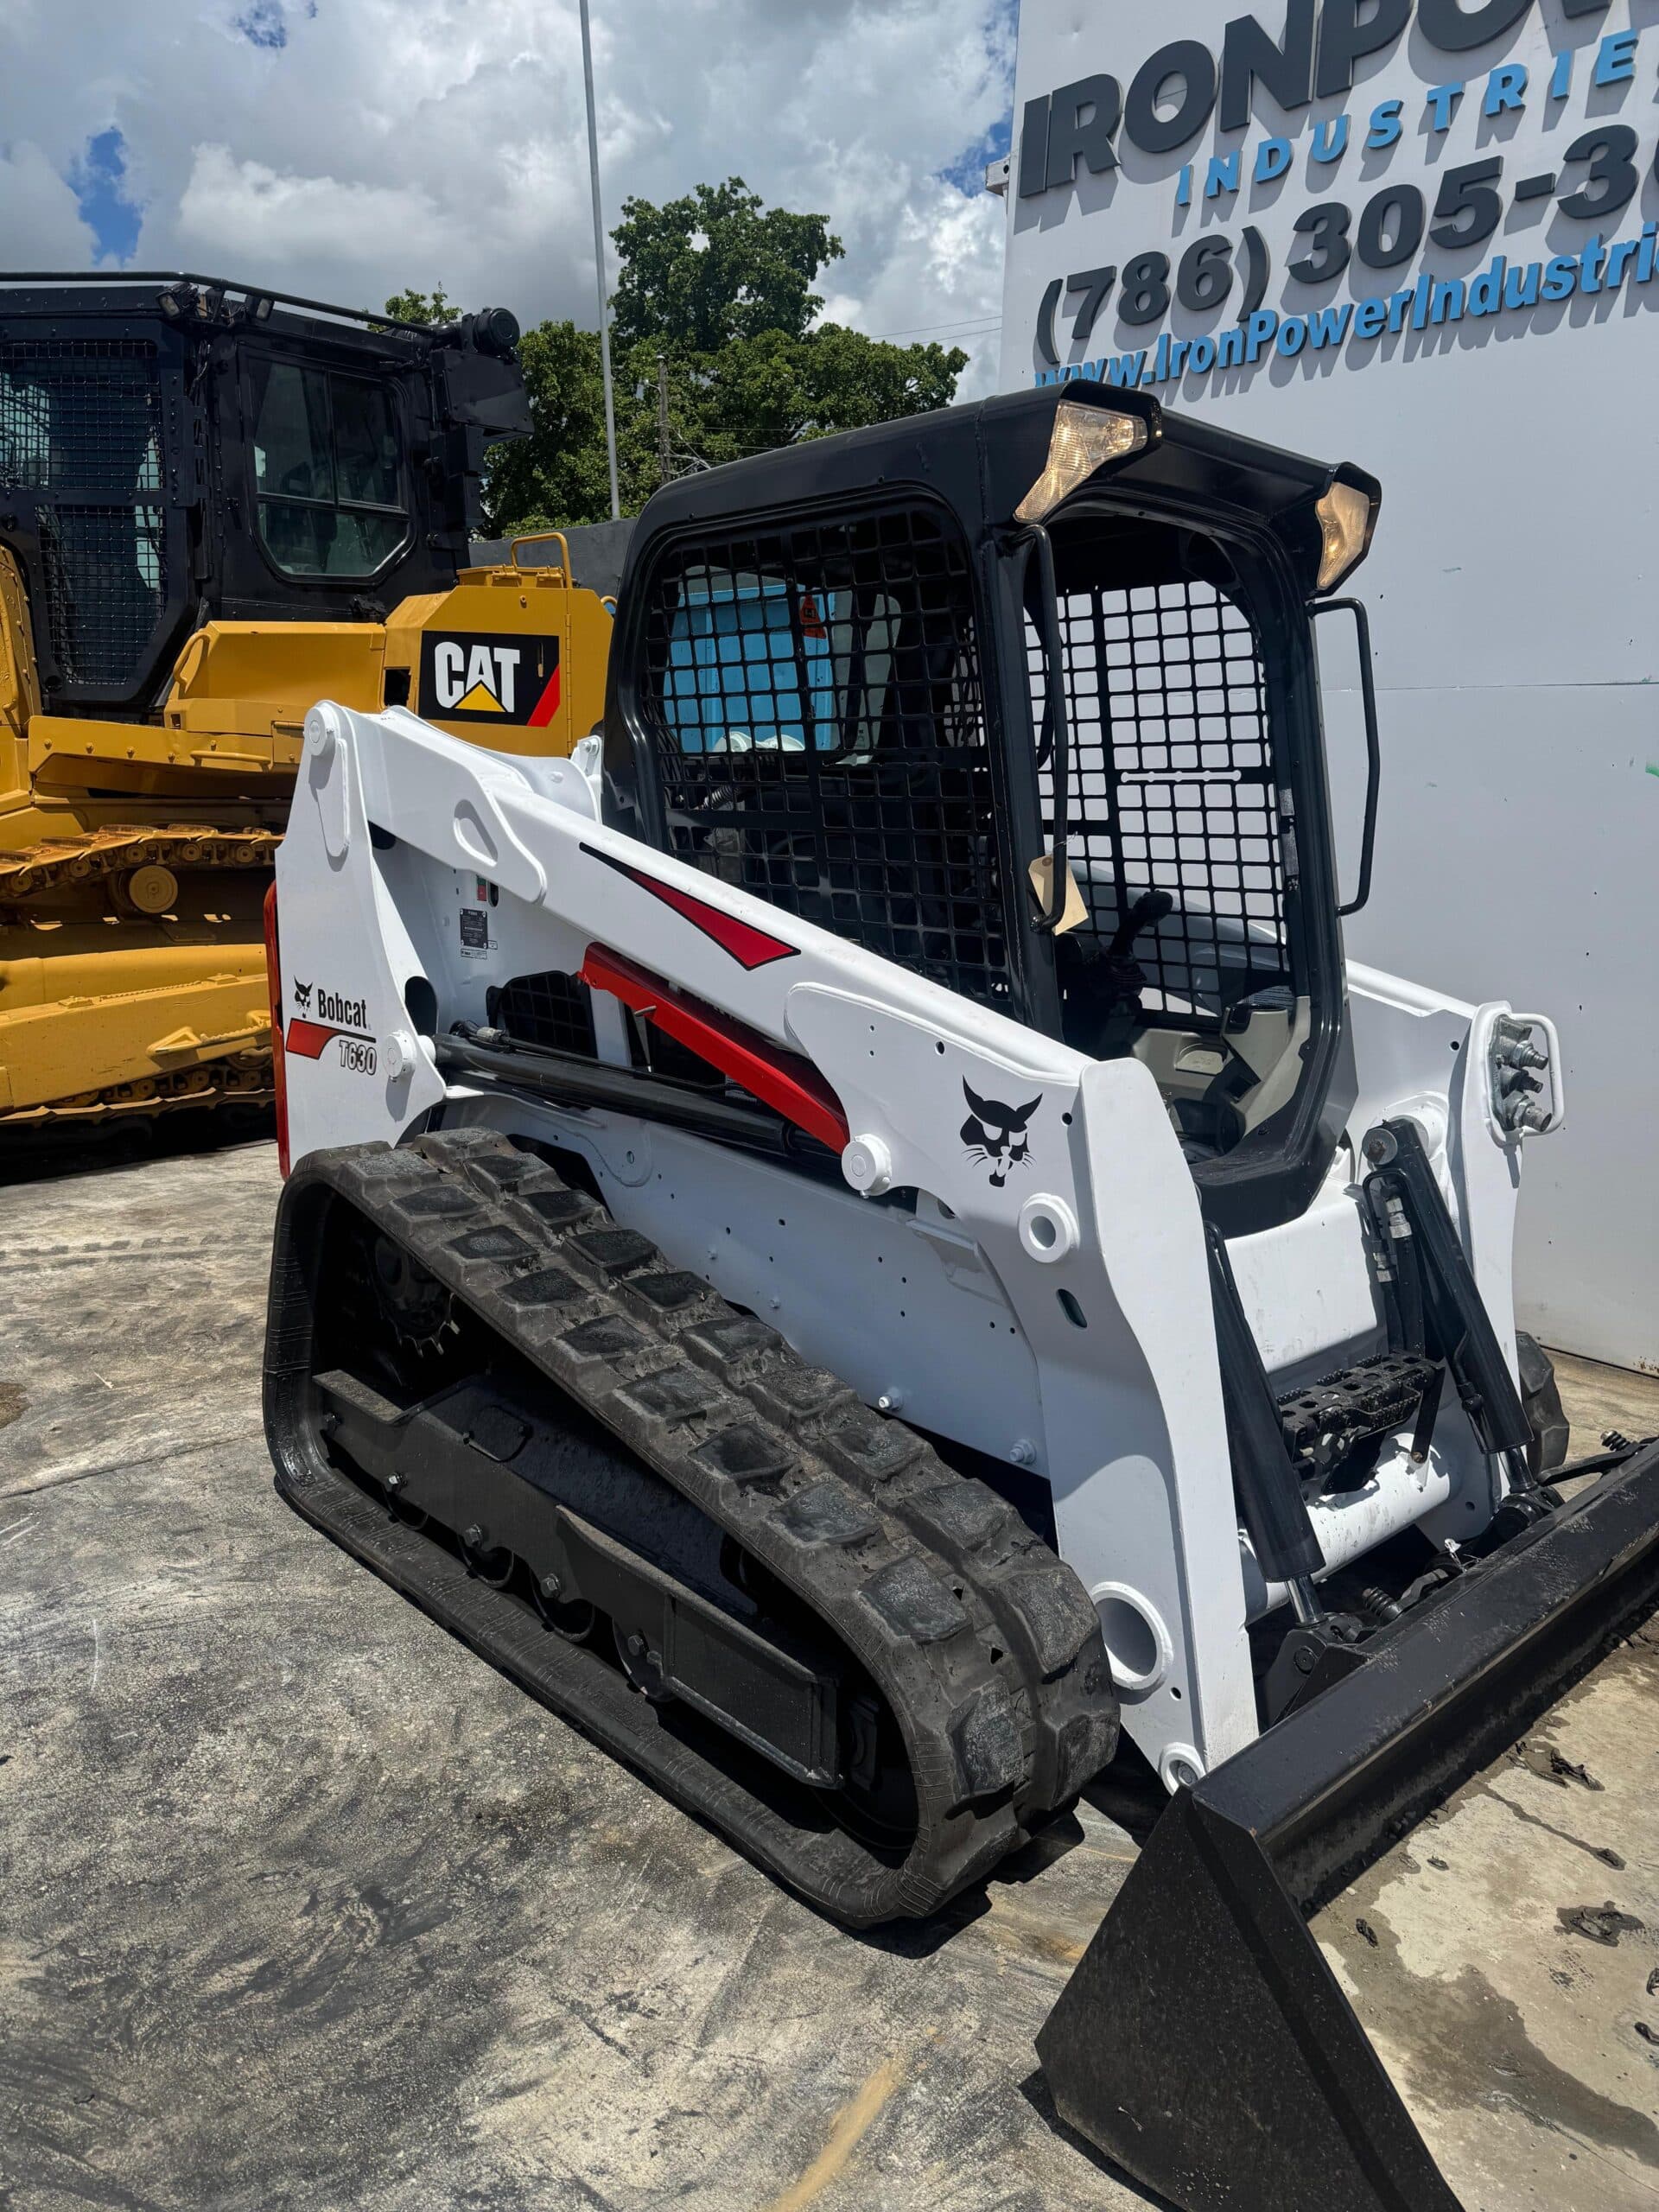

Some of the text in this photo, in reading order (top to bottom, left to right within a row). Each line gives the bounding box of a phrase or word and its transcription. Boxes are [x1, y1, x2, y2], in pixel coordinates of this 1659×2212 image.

[1018, 0, 1612, 199] IRONP
[1176, 28, 1659, 207] INDUSTRIE
[1034, 221, 1659, 388] ww.IronPowerIndustri
[1038, 124, 1659, 365] (786) 305-3
[435, 641, 520, 713] CAT
[318, 988, 367, 1029] Bobcat
[339, 1039, 378, 1076] T630
